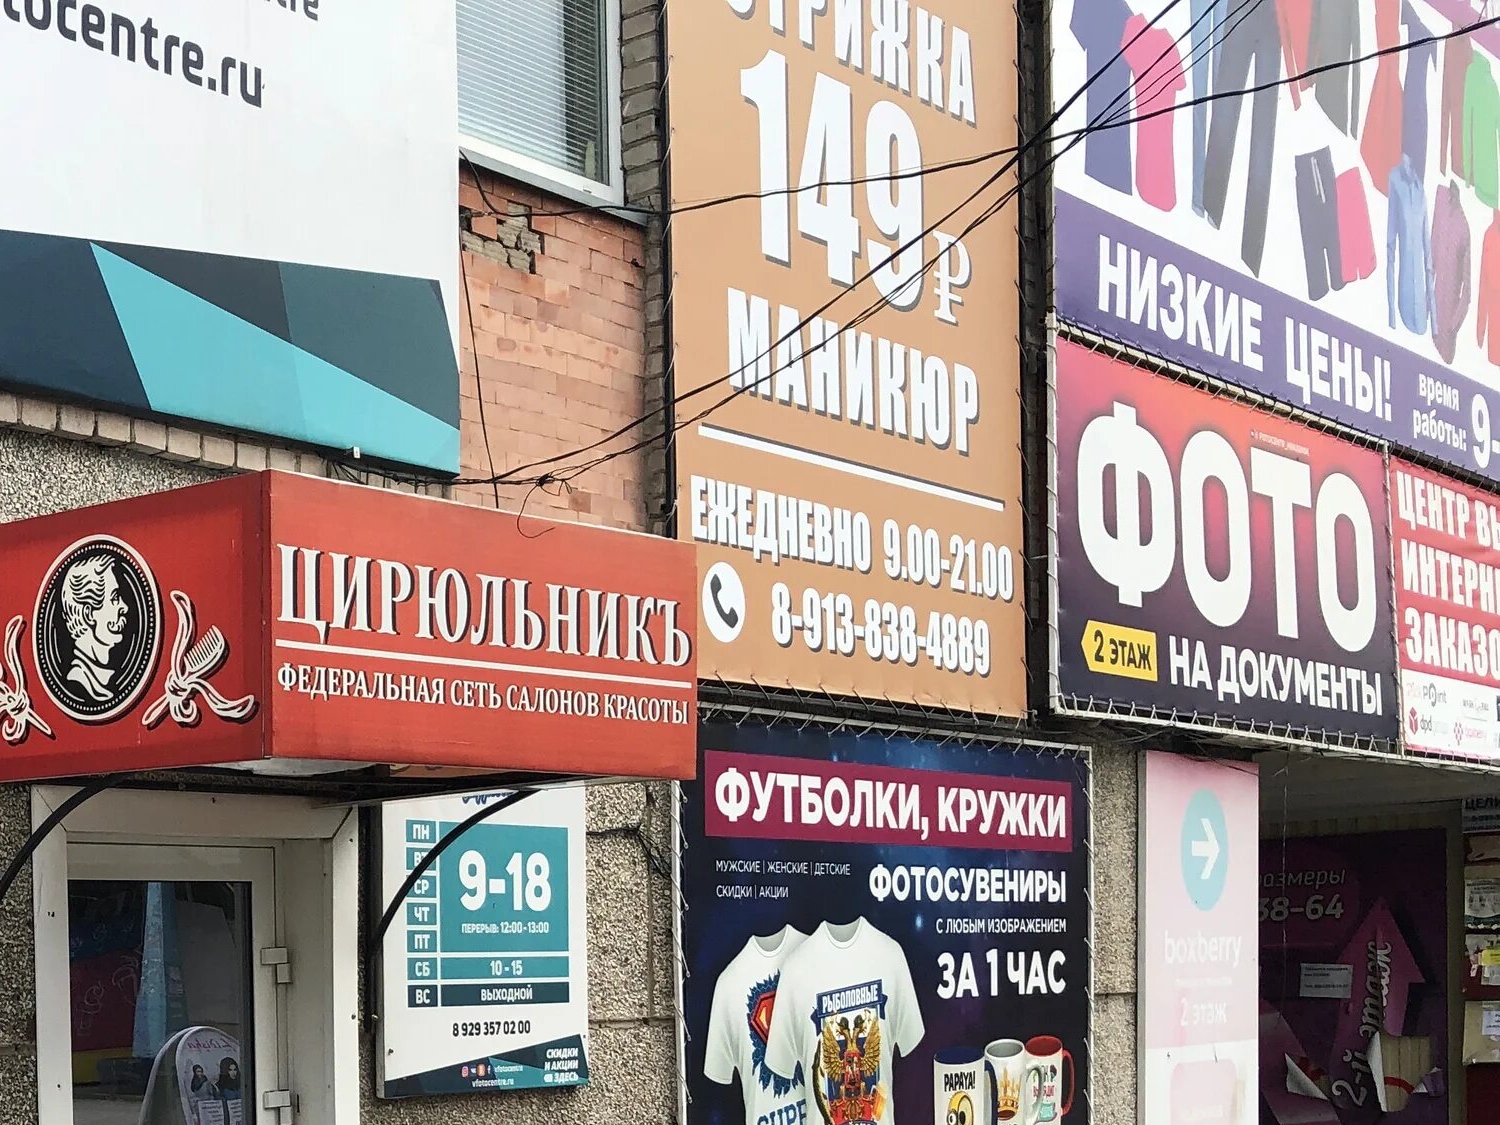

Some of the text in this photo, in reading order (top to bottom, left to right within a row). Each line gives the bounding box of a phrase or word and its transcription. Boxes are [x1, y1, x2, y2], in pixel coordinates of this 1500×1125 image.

[727, 0, 976, 126] ИЖКА
[1099, 235, 1391, 421] НИЗКИЕ ЦЕНЫ!
[727, 287, 978, 454] МАНИКЮР
[1419, 374, 1459, 411] время
[1413, 409, 1466, 451] работы:
[1396, 470, 1469, 539] ЦЕНТР
[690, 475, 1013, 601] ЕЖЕДНЕВНО 9.00-21.00
[1078, 402, 1377, 652] ФОТО
[277, 543, 691, 667] ЦИРЮЛЬНИКЪ
[772, 583, 990, 676] 8-913-838-4889
[1094, 630, 1151, 671] 2 ЭТАЖ
[1169, 635, 1382, 716] НА ДОКУМЕНТЫ
[277, 662, 688, 724] ФЕДЕРАЛЬНАЯ СЕТЬ САЛОНОВ КРАСОТЫ
[715, 767, 1066, 840] ФУТБОЛКИ, КРУЖКИ
[413, 823, 429, 840] ПН
[458, 850, 552, 912] 9-18
[715, 859, 850, 877] МУЖСКИЕ ЖЕНСКИЕ ДЕТСКИЕ
[869, 864, 1066, 903] ФОТОСУВЕНИРЫ
[1259, 869, 1345, 890] азмеры
[414, 879, 429, 895] СР
[716, 885, 789, 899] СКИДКИ АКЦИИ
[414, 906, 429, 922] ЧТ
[461, 923, 499, 934] ПЕРЕРЫВ:
[936, 918, 1066, 934] С ЛЮБЫМ ИЗОБРАЖЕНИЕМ
[414, 934, 430, 950] ПТ
[1164, 929, 1241, 968] boxberry
[415, 961, 430, 977] СБ
[937, 949, 1066, 999] ЗА 1 ЧАС
[415, 988, 430, 1004] ВС
[481, 984, 533, 1002] ВЫХОДНОЙ
[822, 983, 878, 1014] РЫБОЛОВНЫЕ
[452, 1020, 531, 1037] 8 929 357 02 00
[546, 1048, 579, 1059] СКИДКИ
[551, 1060, 578, 1071] АКЦИИ
[554, 1072, 579, 1084] ЗДЕСЬ
[944, 1070, 976, 1093] PAPAYA!
